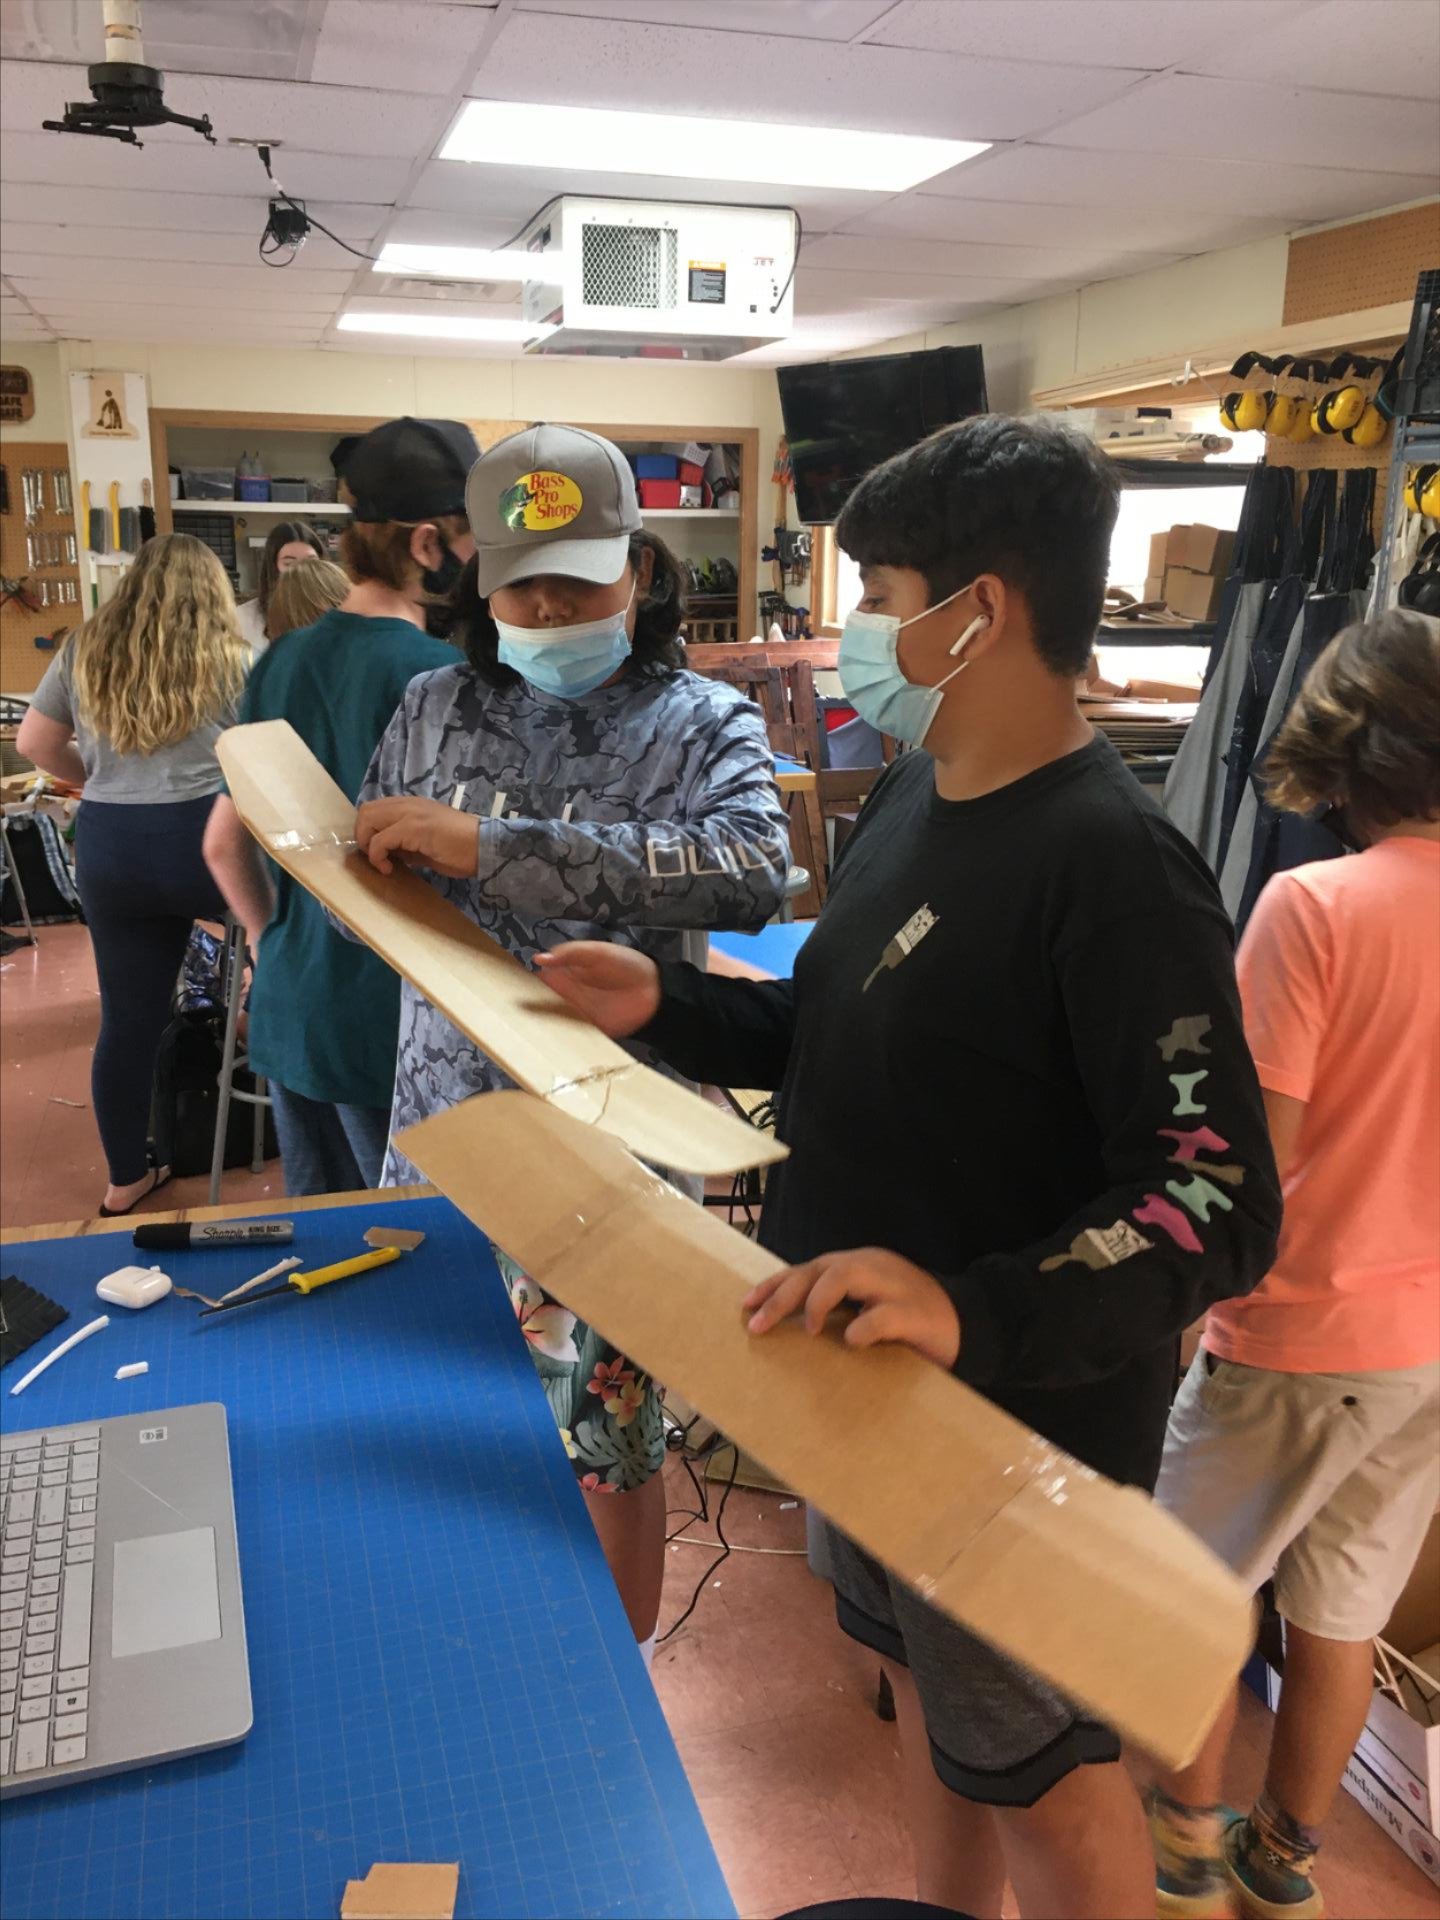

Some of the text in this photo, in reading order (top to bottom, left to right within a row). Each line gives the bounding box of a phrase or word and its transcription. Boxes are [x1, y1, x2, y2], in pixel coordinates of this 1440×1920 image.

[530, 473, 565, 490] Bass
[534, 489, 559, 504] Pro
[536, 503, 577, 520] Shops
[200, 1226, 244, 1240] Sharpie
